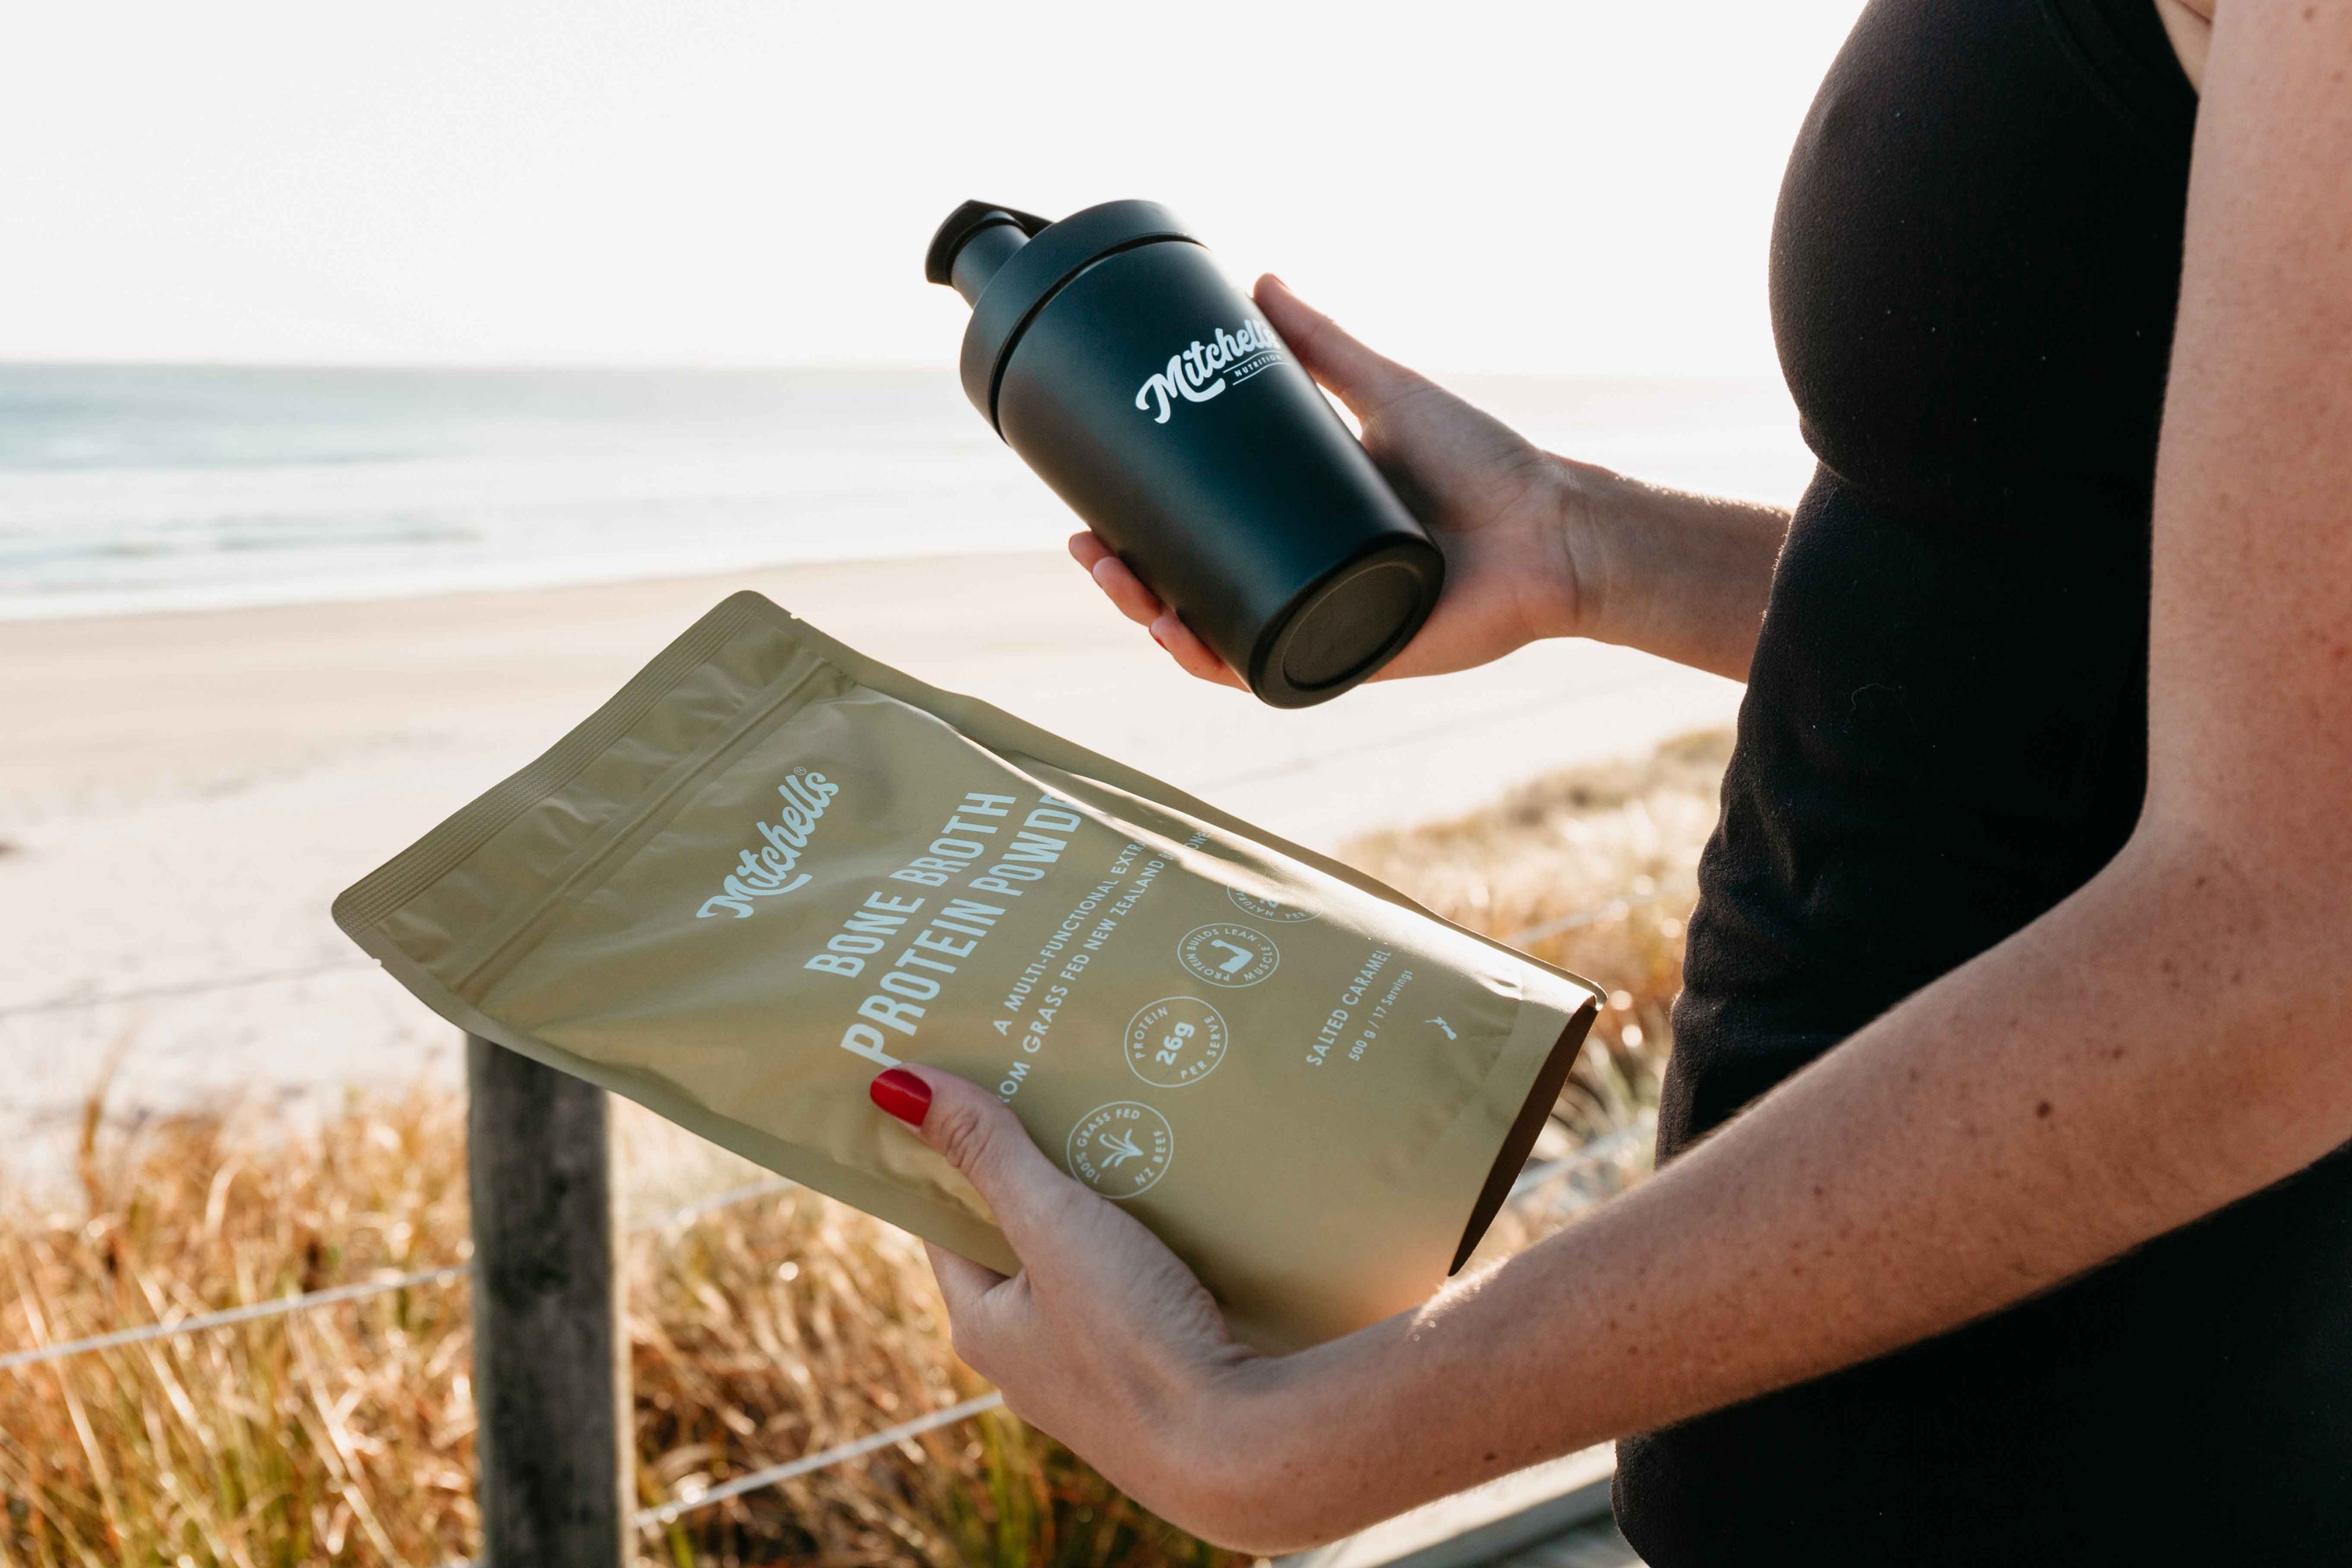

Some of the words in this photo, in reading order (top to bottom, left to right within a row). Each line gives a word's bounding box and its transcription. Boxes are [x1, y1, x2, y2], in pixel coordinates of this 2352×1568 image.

[696, 771, 839, 919] Mitchells
[804, 891, 924, 978] BONE
[889, 792, 1017, 887] BROTH
[993, 1020, 1012, 1036] A
[1004, 880, 1119, 1012] MULTI-FUNCTIONAL
[1022, 985, 1069, 1053] GRASS
[1060, 954, 1091, 981] FED
[1083, 918, 1117, 950] NEW
[1109, 859, 1166, 916] ZEALAND
[1186, 928, 1220, 951] BUILDS
[1224, 927, 1258, 942] LEAN
[1243, 946, 1273, 981] MUSCLE
[840, 898, 1007, 1068] PROTEIN
[1186, 953, 1230, 982] PROTEIN
[1133, 1007, 1168, 1059] PROTEIN
[1306, 1009, 1348, 1066] SALTED
[1341, 949, 1392, 1006] CARAMEL
[1348, 1040, 1368, 1062] 500
[1373, 1006, 1387, 1018] 17
[1381, 969, 1414, 1006] Servings
[1155, 1022, 1196, 1066] 26g
[1181, 1061, 1207, 1080] PER
[1203, 1015, 1221, 1058] SERVE
[1076, 1112, 1111, 1147] GRASS
[1116, 1108, 1141, 1120] FED
[1134, 1167, 1155, 1185] NZ
[1152, 1130, 1167, 1163] BEEF
